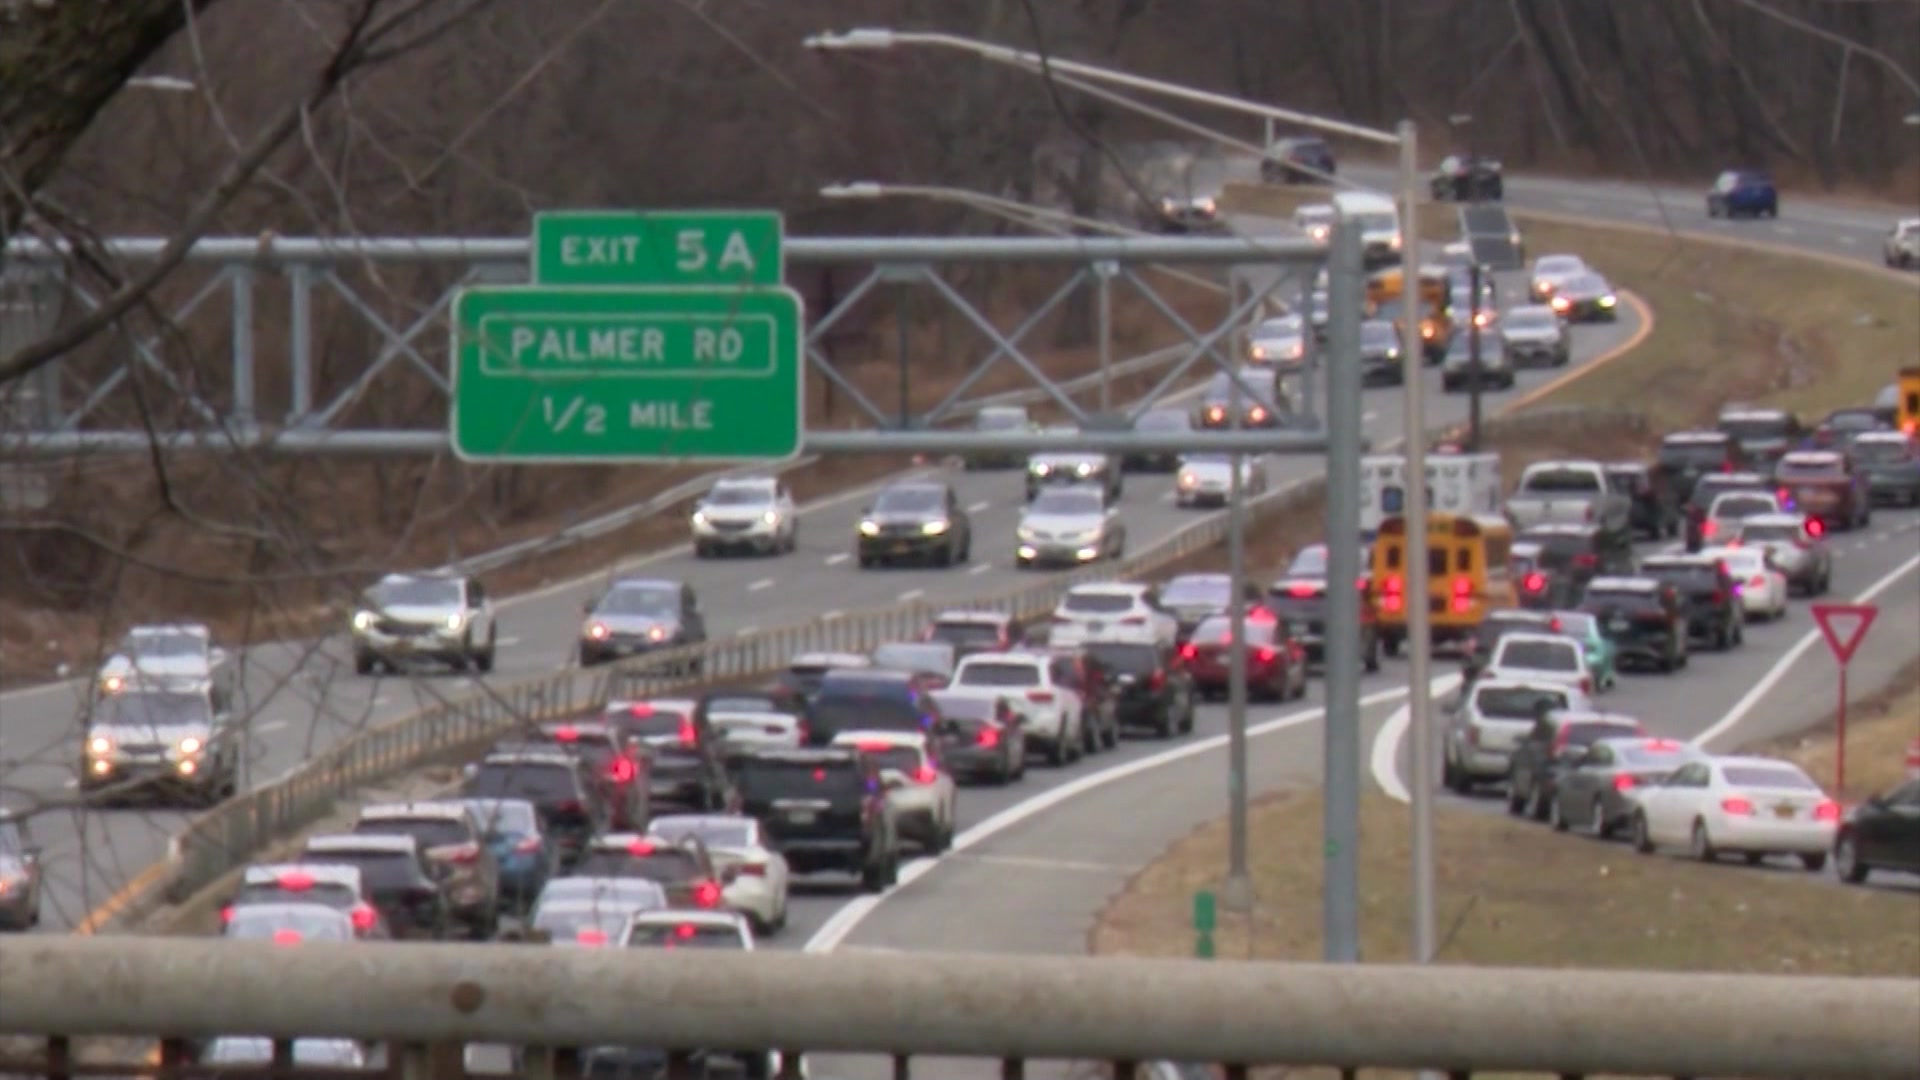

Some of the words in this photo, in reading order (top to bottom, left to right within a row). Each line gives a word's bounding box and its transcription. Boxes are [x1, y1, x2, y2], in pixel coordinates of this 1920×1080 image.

[561, 235, 638, 264] EXIT
[511, 327, 665, 362] PALMER
[693, 327, 744, 362] RD
[628, 401, 714, 430] MILE
